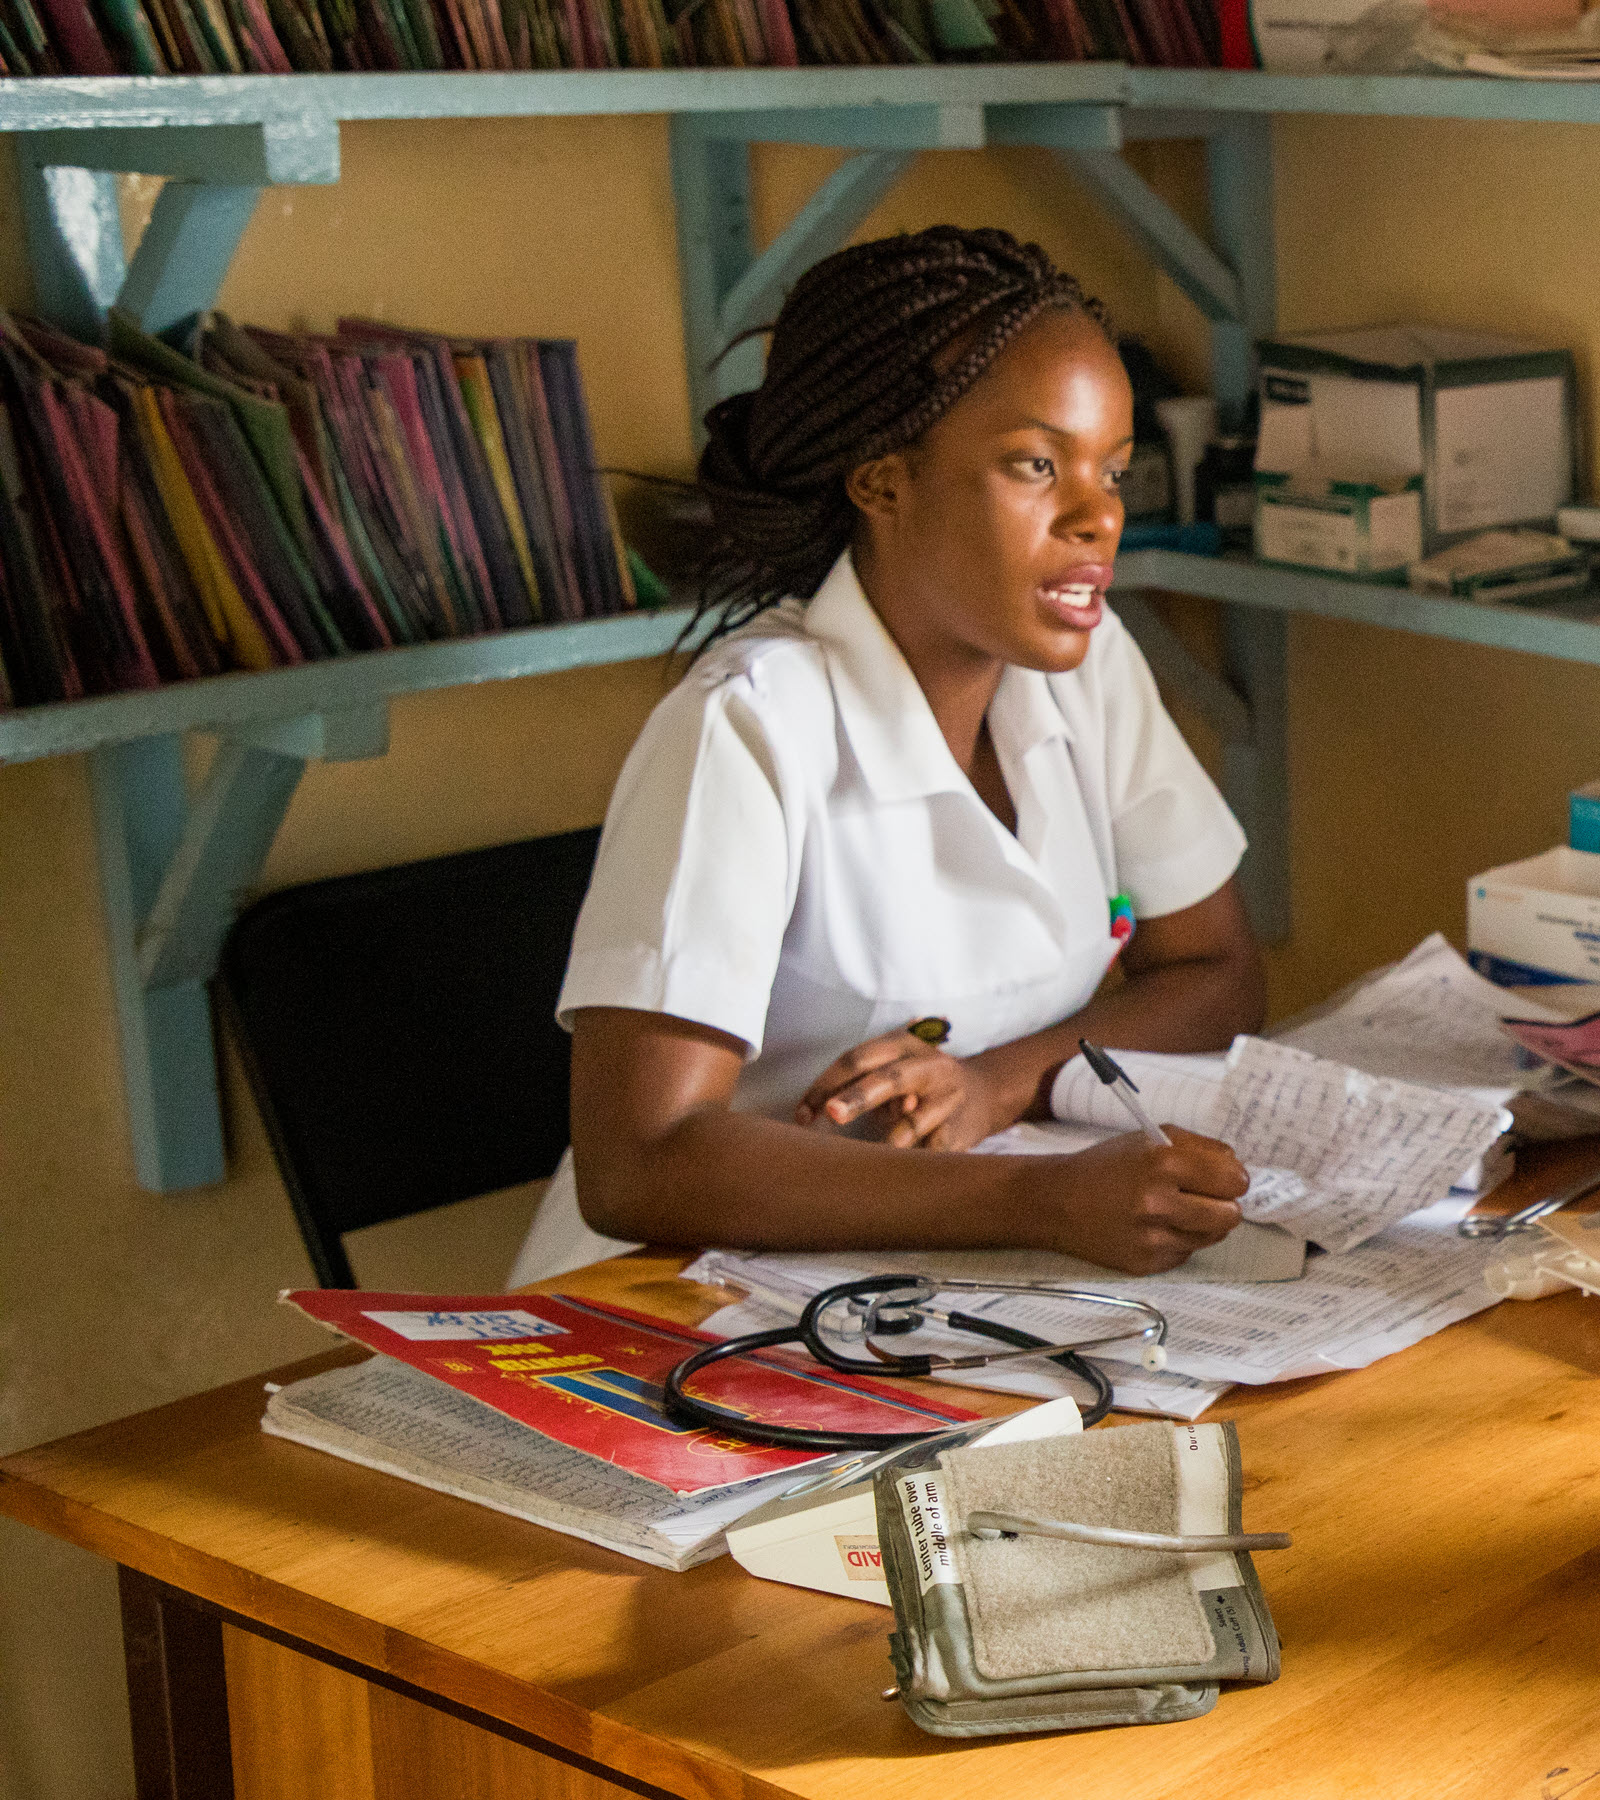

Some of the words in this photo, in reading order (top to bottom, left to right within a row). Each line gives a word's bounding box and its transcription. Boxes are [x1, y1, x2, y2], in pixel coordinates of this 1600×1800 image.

[476, 1343, 555, 1356] BOOK
[488, 1353, 604, 1371] COUNTER
[1189, 1435, 1198, 1451] Our
[904, 1480, 918, 1503] over
[925, 1481, 938, 1503] arm
[910, 1505, 925, 1537] tube
[926, 1507, 940, 1519] of
[931, 1523, 950, 1567] middle
[847, 1551, 881, 1567] AID
[918, 1539, 933, 1581] Center
[1214, 1607, 1227, 1628] Select
[1229, 1617, 1241, 1631] Cuff
[1235, 1633, 1247, 1653] Adult
